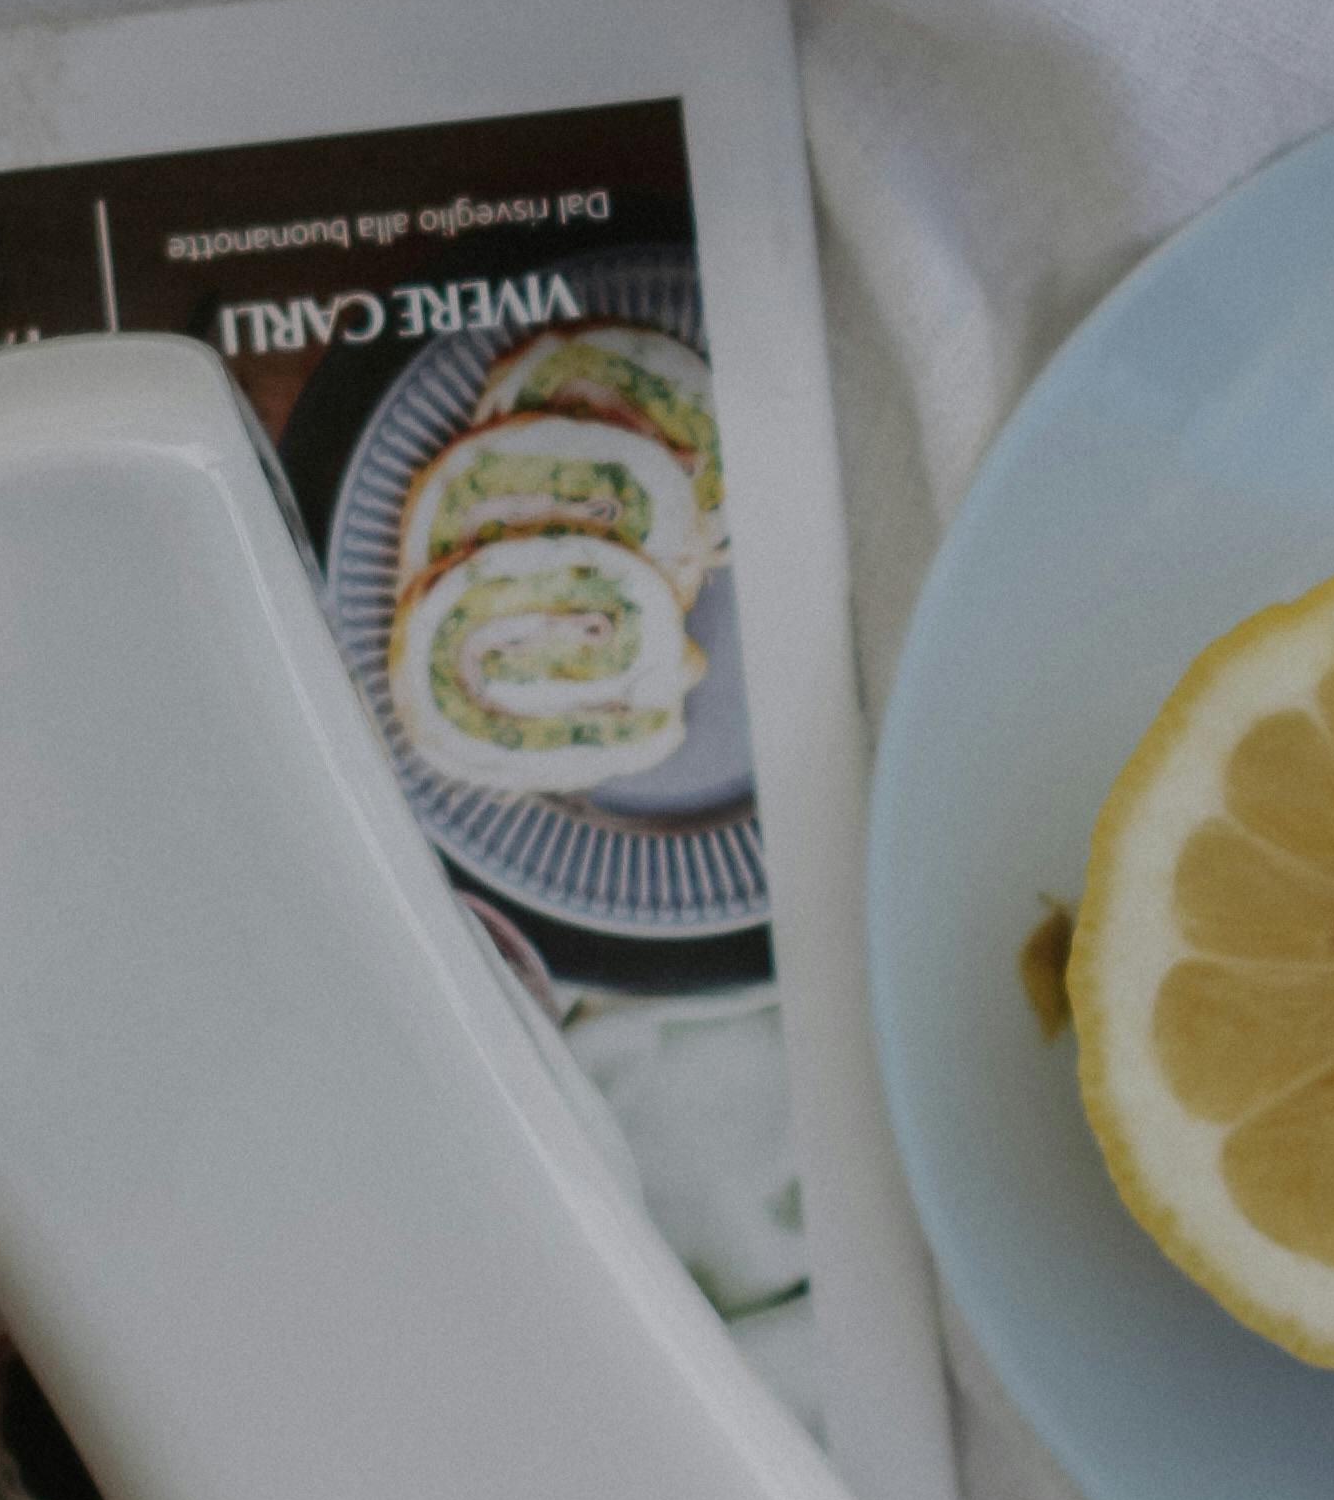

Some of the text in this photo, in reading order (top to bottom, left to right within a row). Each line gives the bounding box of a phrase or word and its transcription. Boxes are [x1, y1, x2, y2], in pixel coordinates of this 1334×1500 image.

[163, 189, 611, 264] Dal risveglio alla buonanotte
[217, 270, 580, 358] VIVERE CARLI
